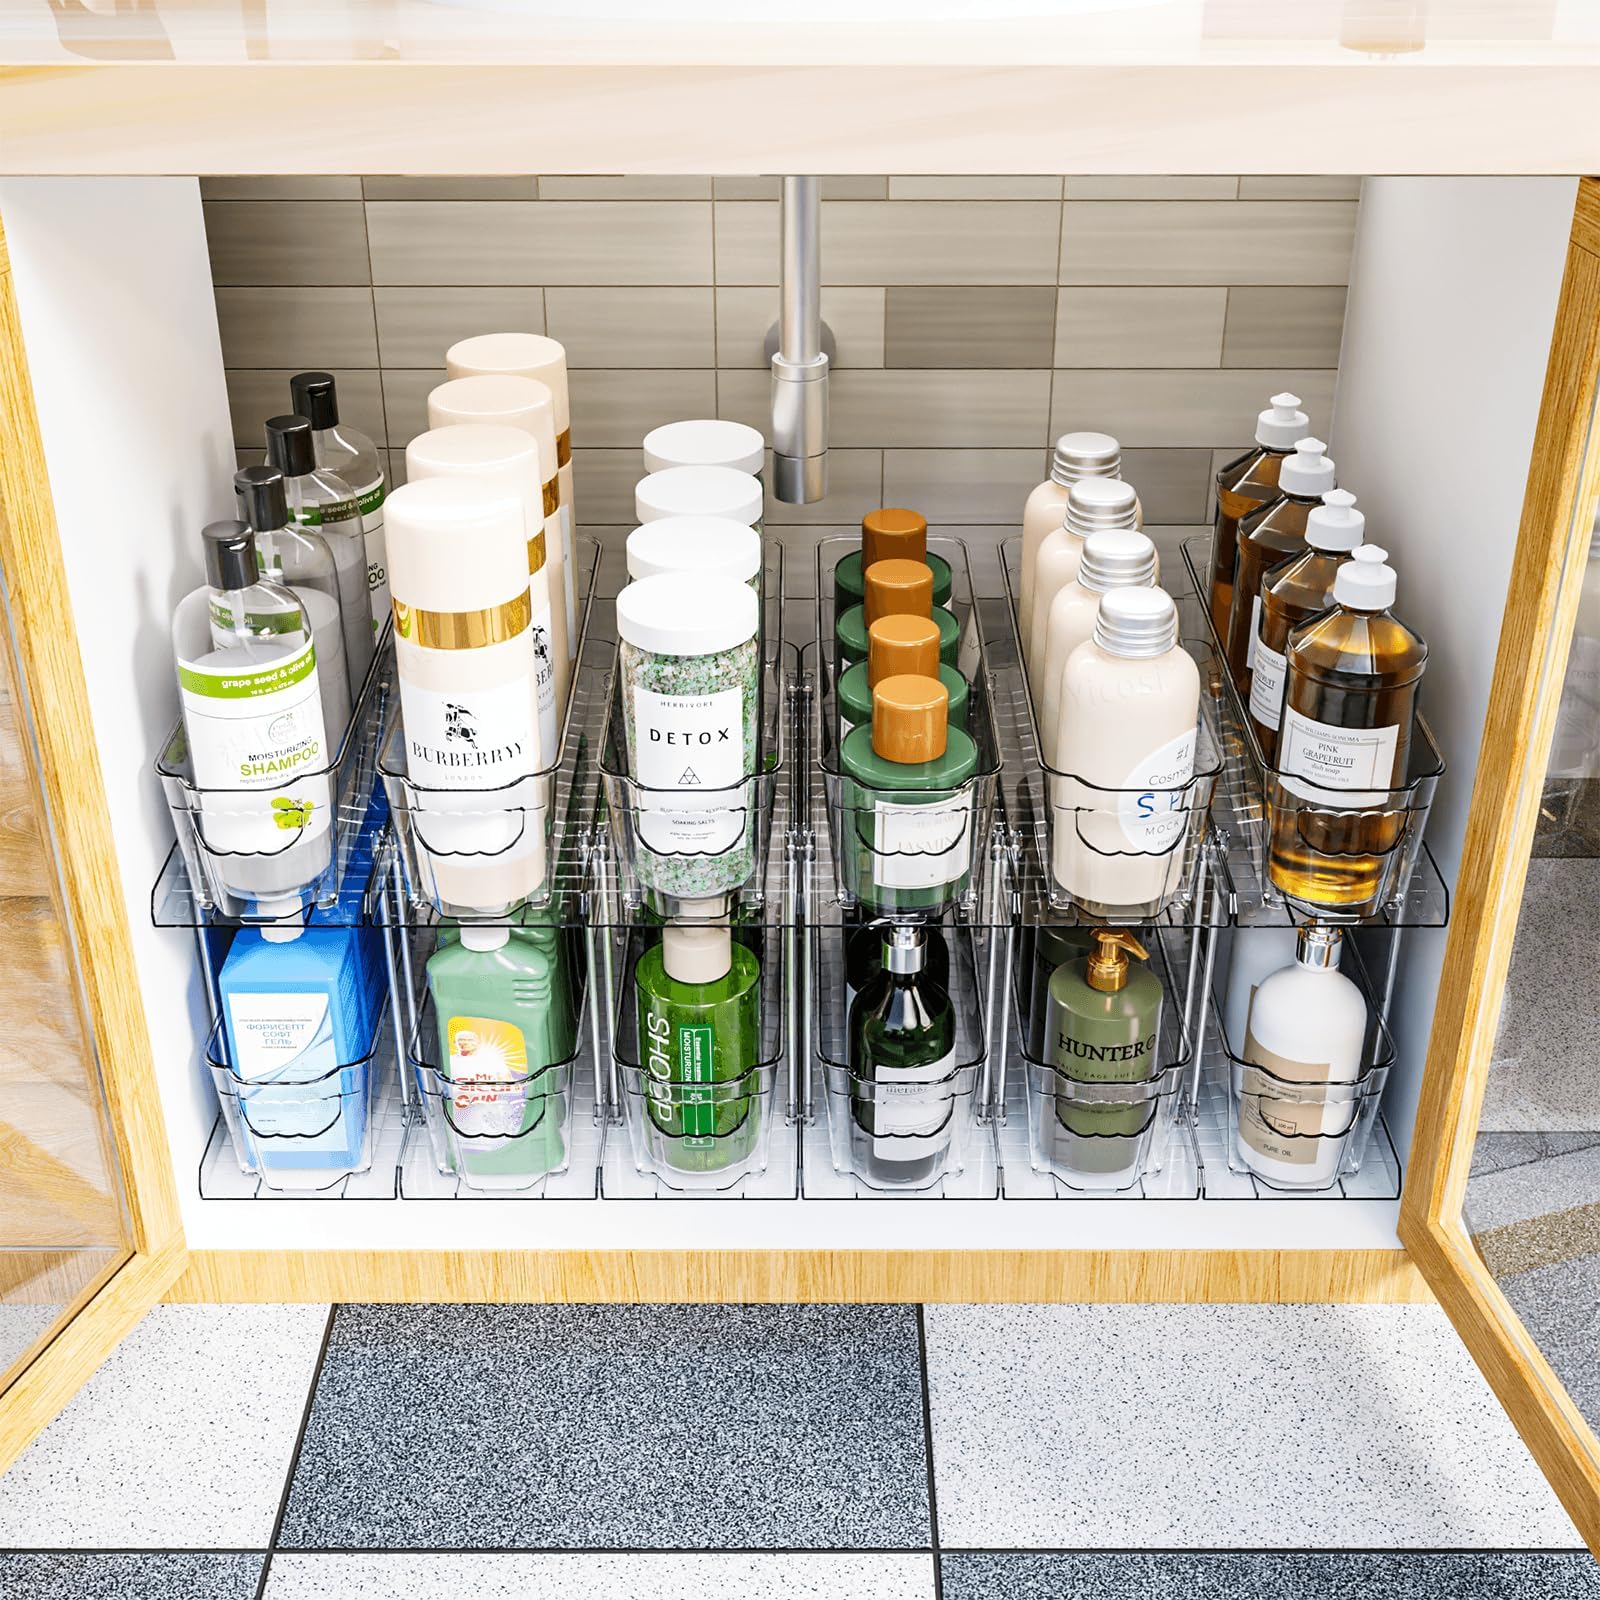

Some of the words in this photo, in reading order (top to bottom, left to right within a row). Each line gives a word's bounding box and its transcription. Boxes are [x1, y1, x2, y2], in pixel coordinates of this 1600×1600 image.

[221, 679, 251, 689] grape
[254, 672, 278, 685] seed
[279, 669, 288, 678] &
[288, 660, 305, 674] olive
[650, 728, 729, 745] DETOX
[248, 736, 312, 761] MOISTURIZING
[1303, 748, 1355, 765] GRAPEFRUIT
[1319, 743, 1338, 753] PINK
[240, 742, 319, 776] SHAMPOO
[1264, 1144, 1278, 1153] PURE
